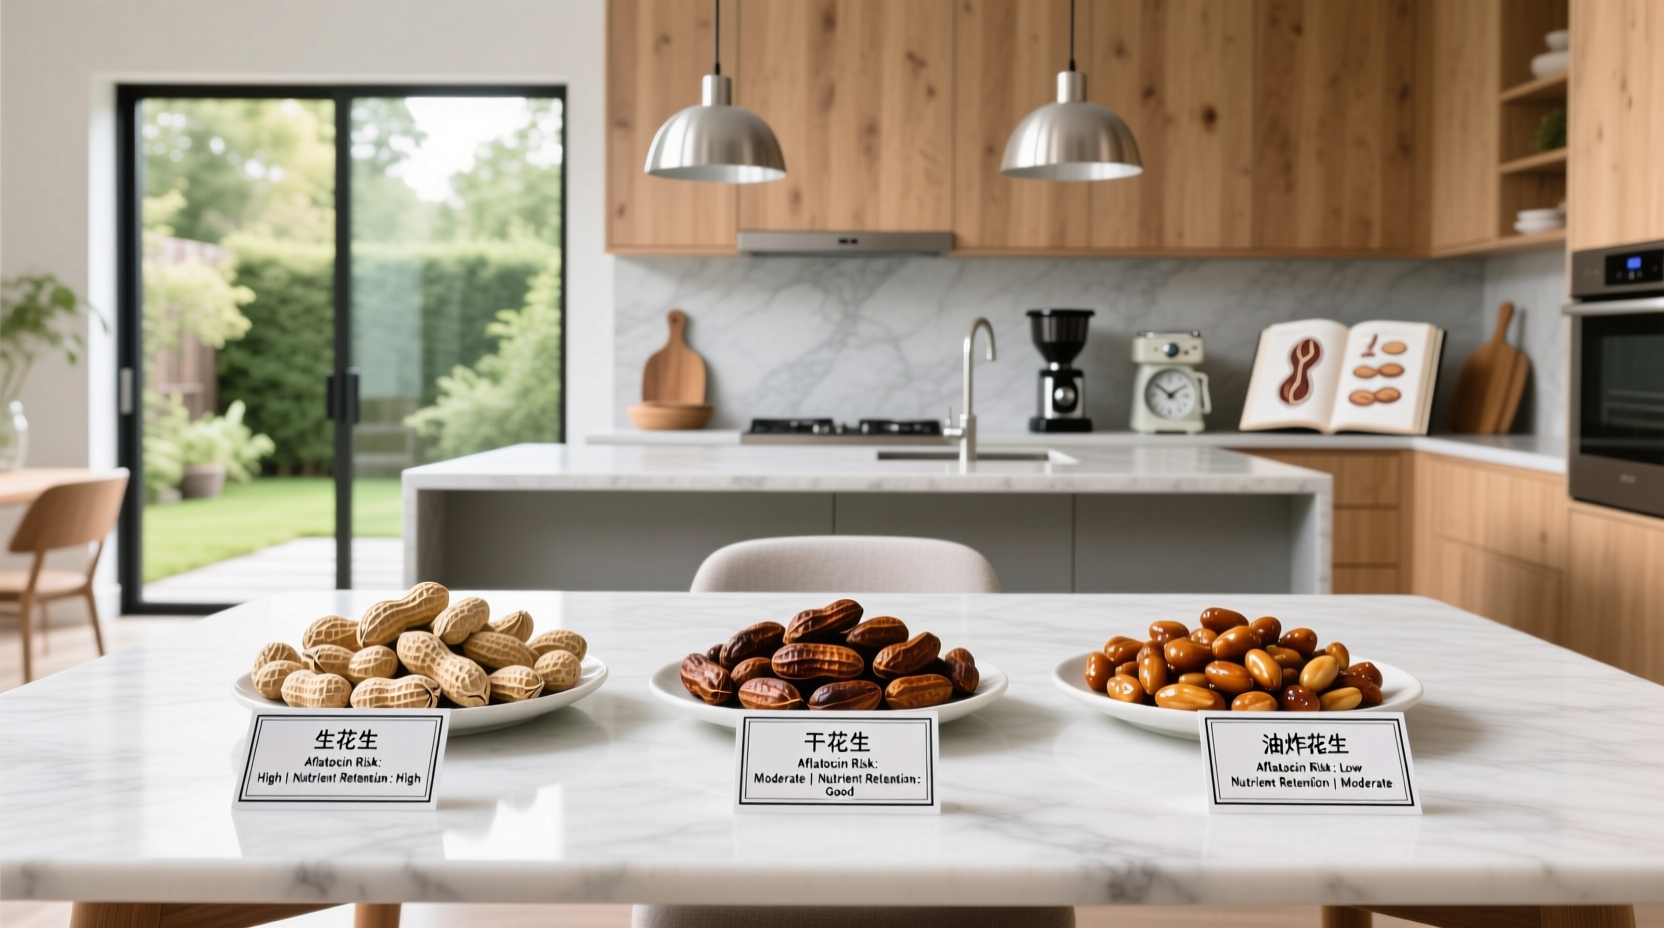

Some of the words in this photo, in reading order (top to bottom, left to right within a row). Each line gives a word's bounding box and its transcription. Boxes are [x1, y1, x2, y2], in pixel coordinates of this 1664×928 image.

[314, 729, 378, 750] 生花生
[805, 731, 870, 753] 干花生
[1262, 732, 1349, 756] 油炸花生
[1340, 763, 1362, 773] Low
[257, 772, 281, 785] High
[396, 773, 421, 786] High
[754, 773, 805, 784] Moderate
[1341, 778, 1393, 788] Moderate
[826, 787, 854, 796] Good
